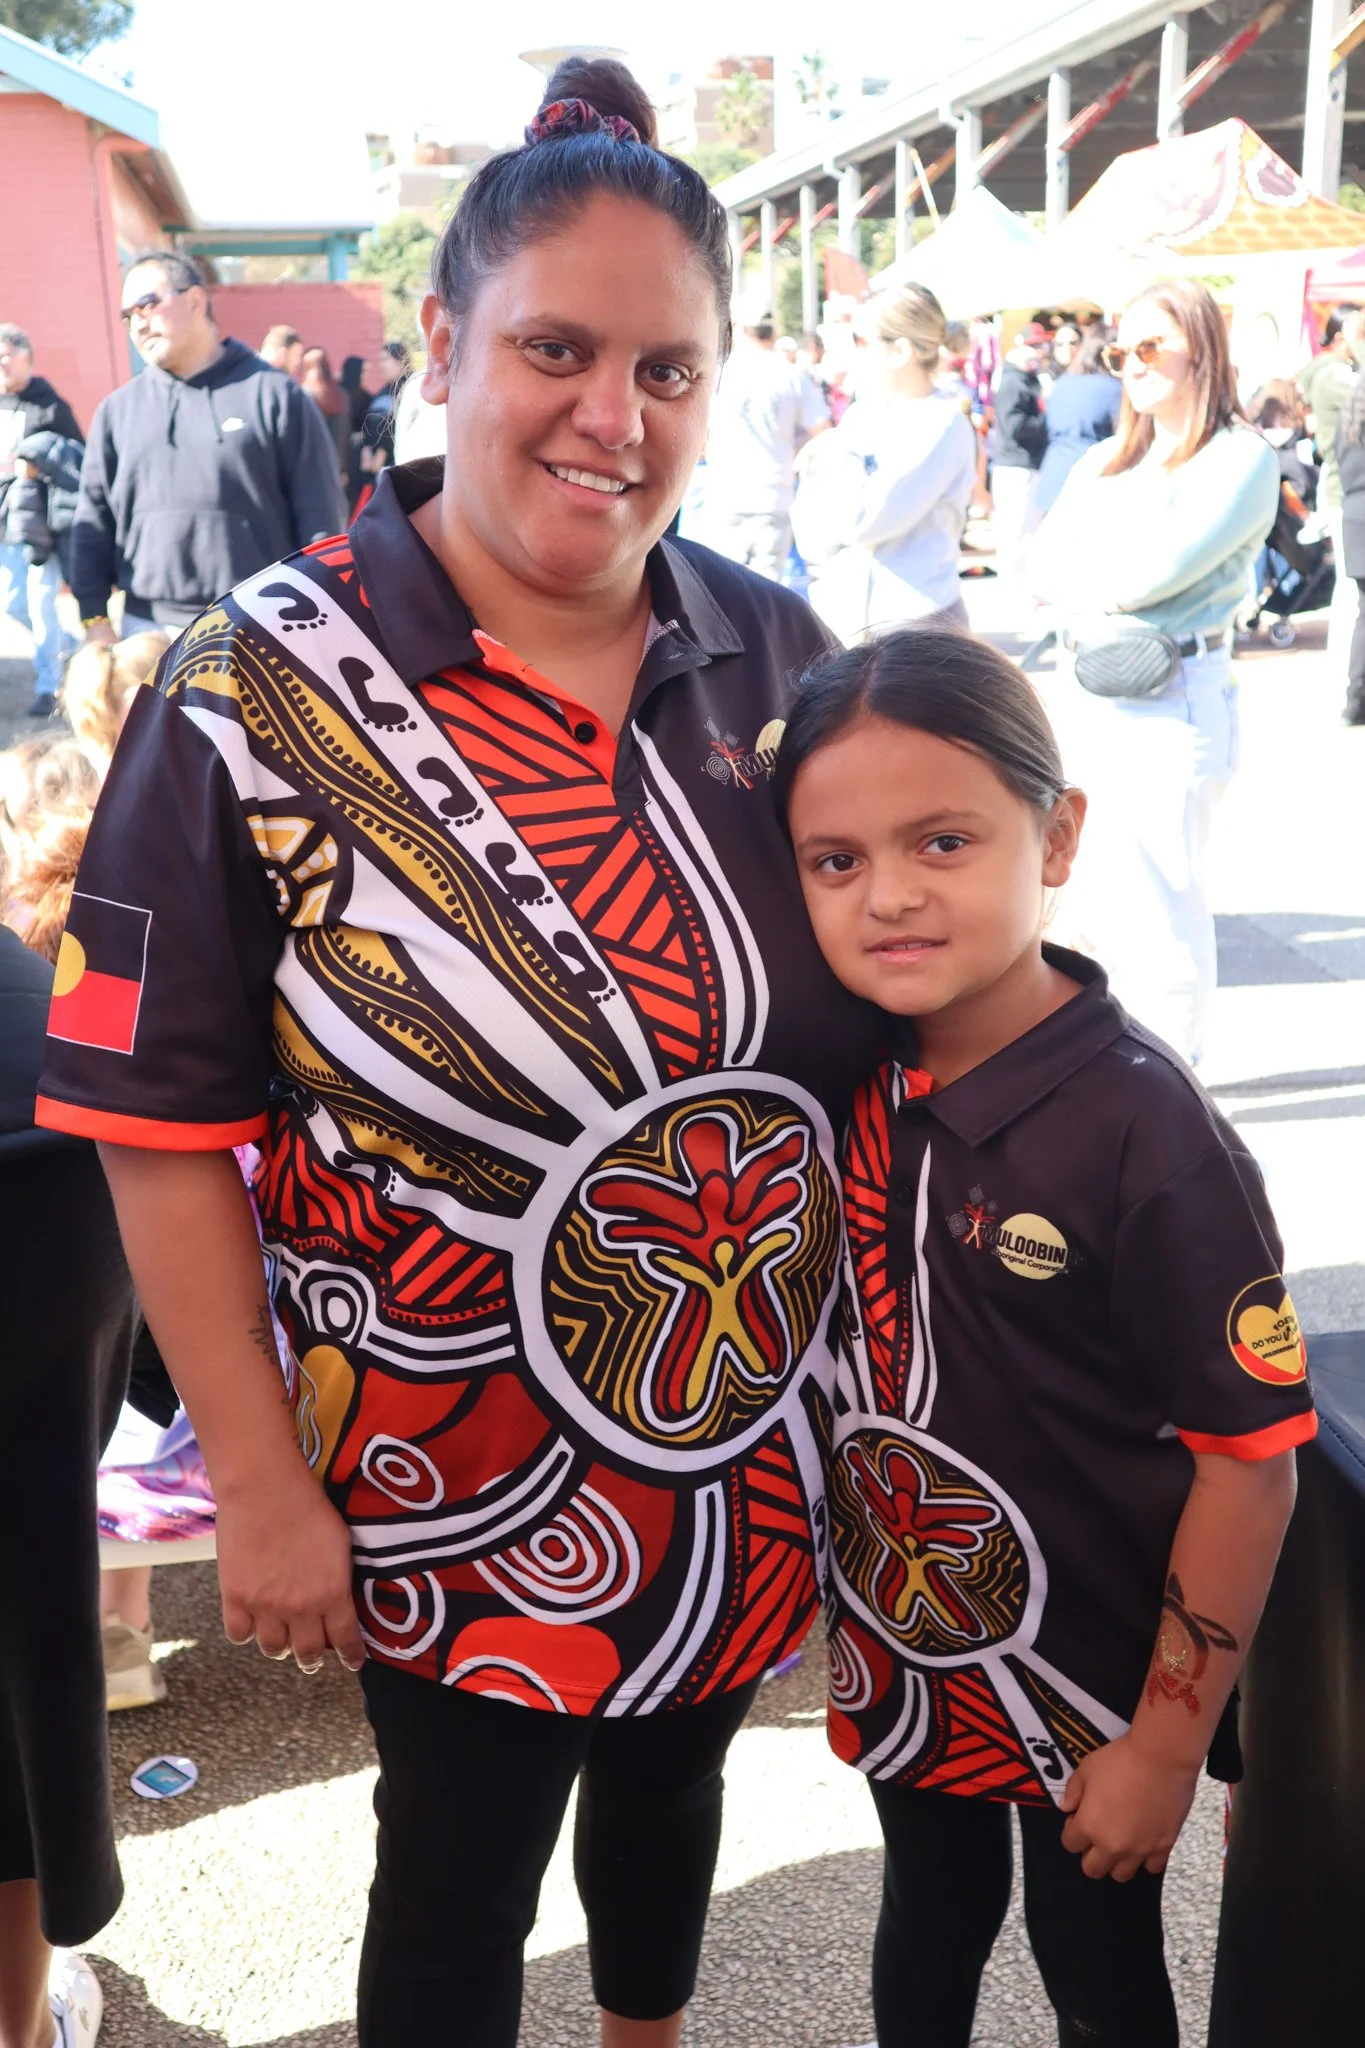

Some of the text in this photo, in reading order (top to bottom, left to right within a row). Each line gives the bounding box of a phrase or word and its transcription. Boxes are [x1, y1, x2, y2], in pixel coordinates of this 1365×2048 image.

[982, 1225, 1082, 1265] MULOOBIN
[1252, 1340, 1264, 1349] DO
[1265, 1334, 1282, 1344] YOU
